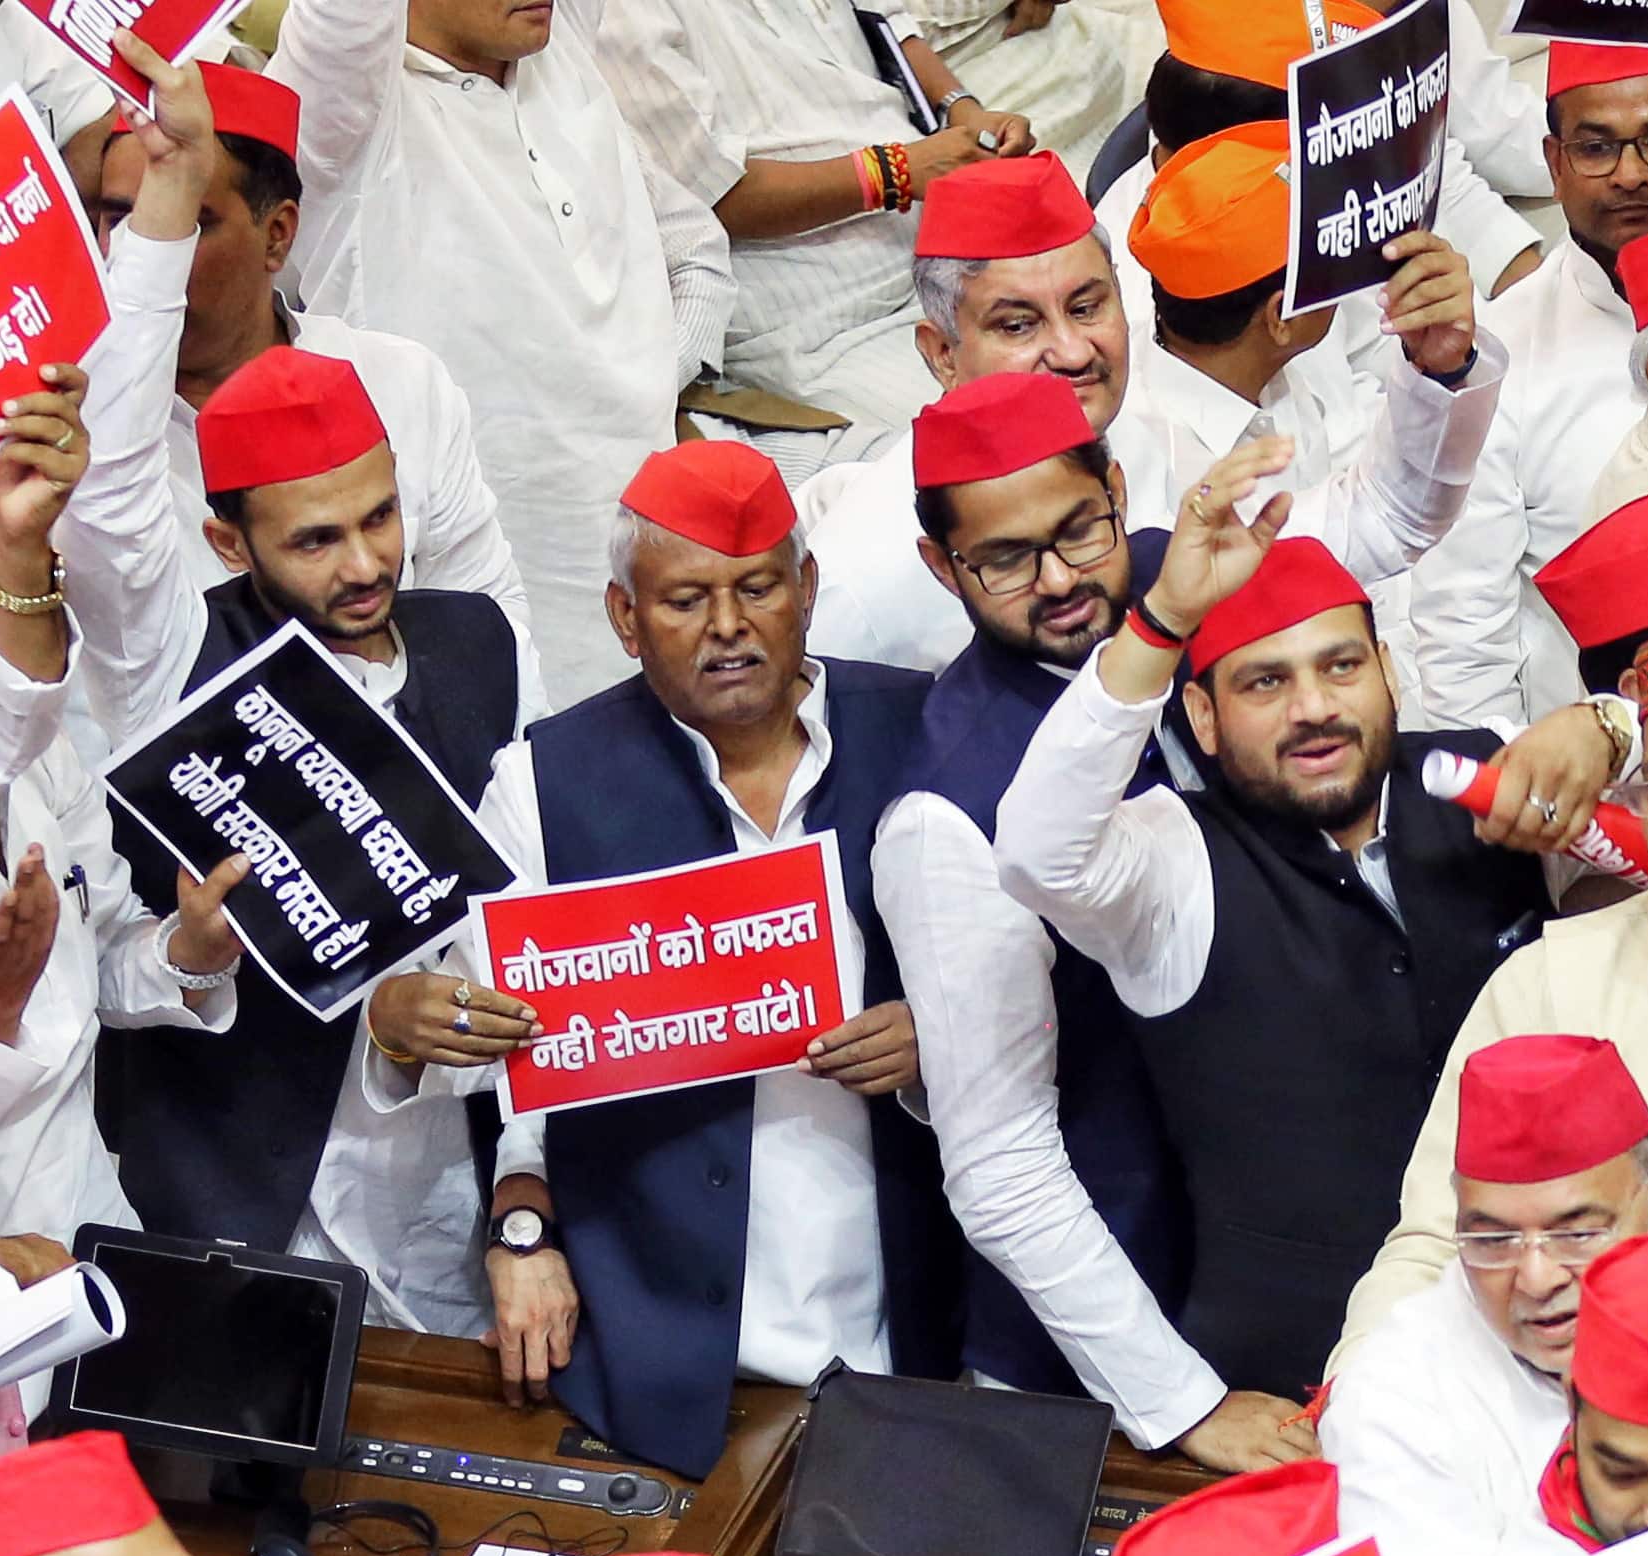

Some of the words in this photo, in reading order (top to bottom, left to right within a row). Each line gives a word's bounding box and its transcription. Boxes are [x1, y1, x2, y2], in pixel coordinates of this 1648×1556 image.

[1306, 76, 1394, 167] नौजवानों
[1394, 65, 1417, 129] को
[1416, 51, 1448, 113] नफरत
[1316, 188, 1361, 258] नही
[1364, 180, 1425, 243] रोजगार
[9, 286, 53, 340] दो।
[232, 684, 310, 767] कानून
[294, 743, 384, 835] व्यवस्था
[359, 819, 430, 896] ध्वस्त
[168, 752, 247, 818] योगी
[212, 801, 301, 890] सरकार
[275, 868, 342, 939] मस्त
[310, 918, 371, 971] है।
[499, 921, 653, 994] नौजवानों
[655, 912, 706, 969] को
[710, 901, 819, 957] नफरत
[529, 1013, 597, 1072] नही
[601, 1005, 729, 1060] रोजगार
[732, 978, 818, 1037] बांटो।
